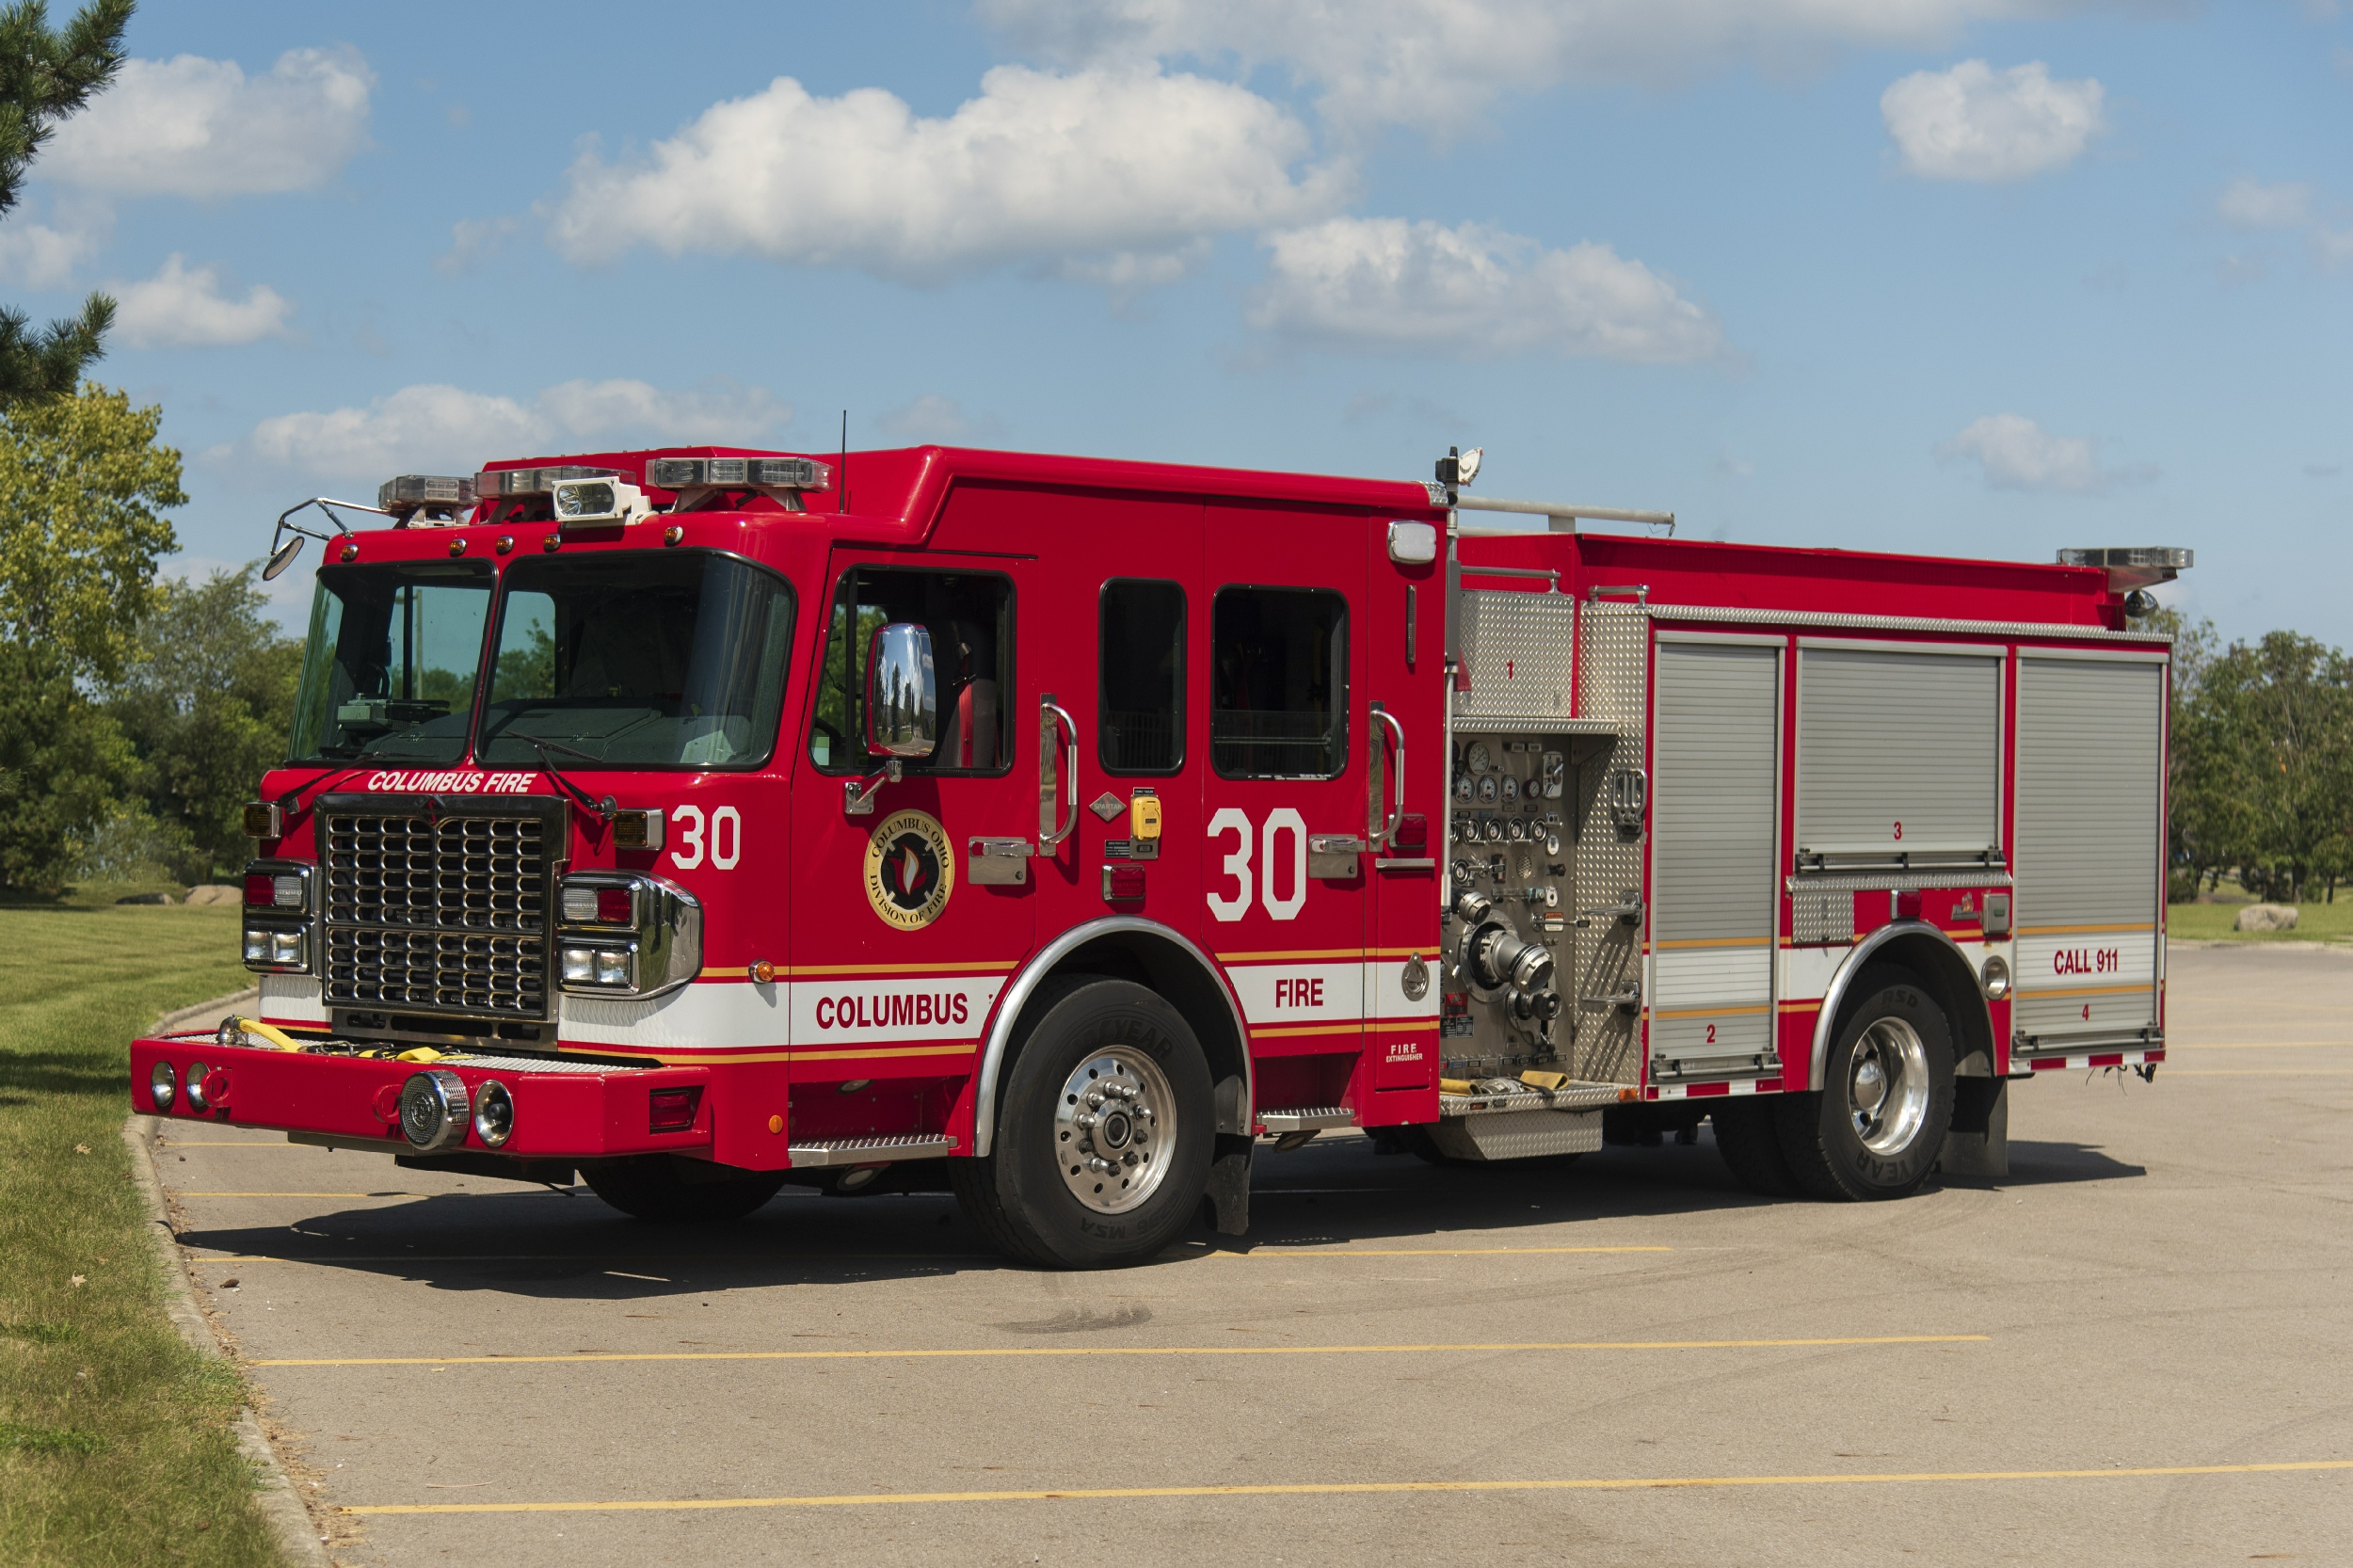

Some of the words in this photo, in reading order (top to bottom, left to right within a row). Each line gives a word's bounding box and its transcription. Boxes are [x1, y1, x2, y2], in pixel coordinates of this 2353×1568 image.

[1506, 660, 1513, 680] 1
[367, 771, 484, 792] COLUMBUS
[482, 773, 537, 793] FIRE
[670, 804, 741, 871] 30
[1894, 821, 1902, 840] 3
[872, 817, 931, 858] COLUMBUS
[930, 830, 950, 869] OHIO
[1207, 808, 1307, 922] 30
[870, 874, 907, 924] DIVISION
[909, 910, 925, 924] OF
[926, 883, 948, 916] FIRE
[2054, 949, 2092, 975] CALL
[2096, 948, 2119, 973] 911
[1275, 977, 1324, 1009] FIRE
[1881, 989, 1919, 1010] RSD
[816, 992, 968, 1030] COLUMBUS
[2081, 1003, 2089, 1021] 4
[1706, 1024, 1716, 1044] 2
[1385, 1053, 1423, 1063] EXTINGUISHER
[1390, 1043, 1417, 1055] FIRE
[1080, 1217, 1127, 1240] MSA
